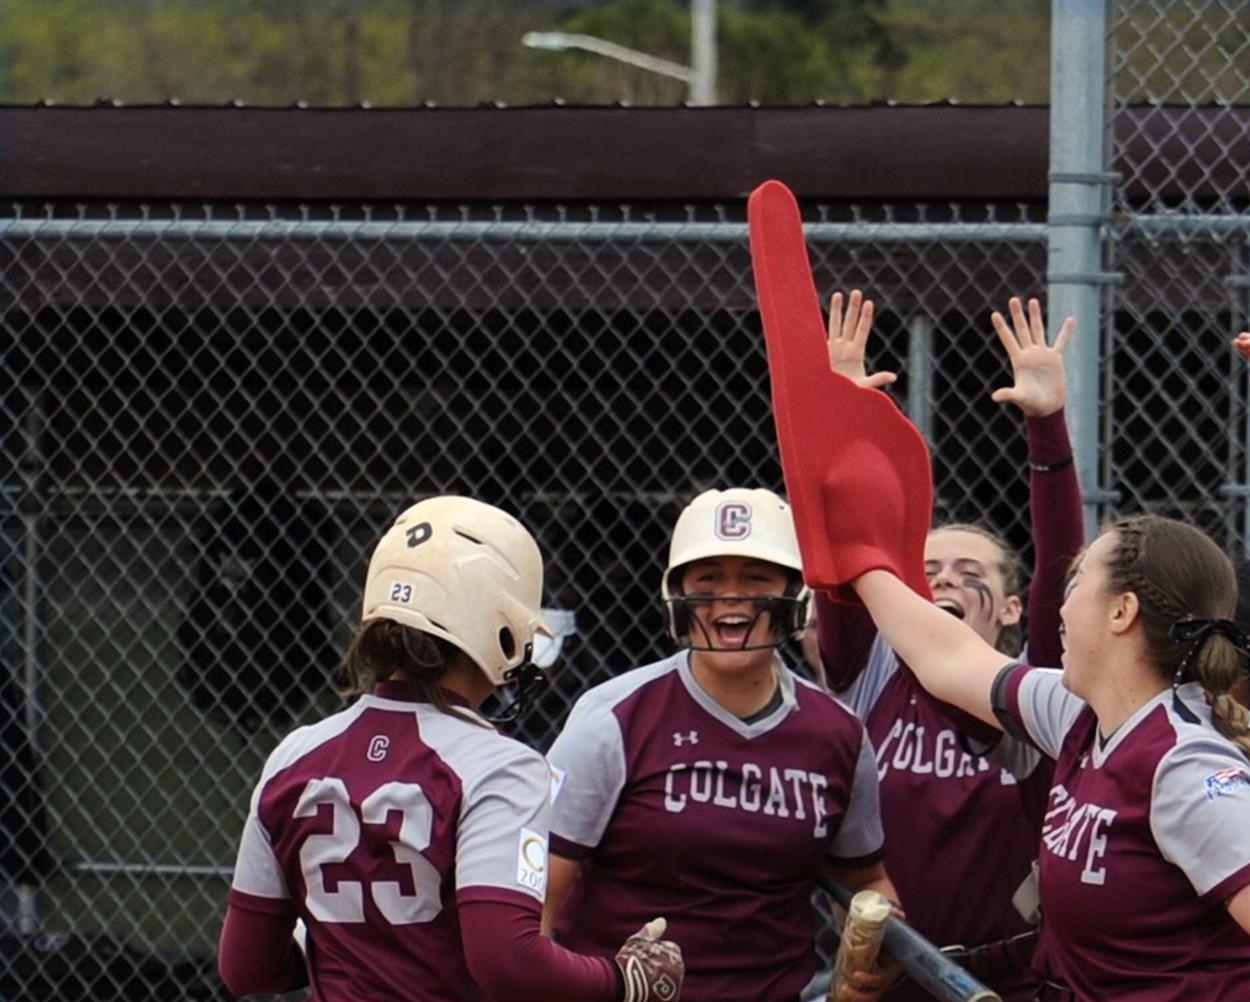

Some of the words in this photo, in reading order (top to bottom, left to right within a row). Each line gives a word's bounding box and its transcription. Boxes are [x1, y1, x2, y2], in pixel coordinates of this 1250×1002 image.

[391, 583, 412, 603] 23
[366, 735, 390, 762] C
[664, 760, 828, 838] COLGATE
[292, 776, 443, 925] 23
